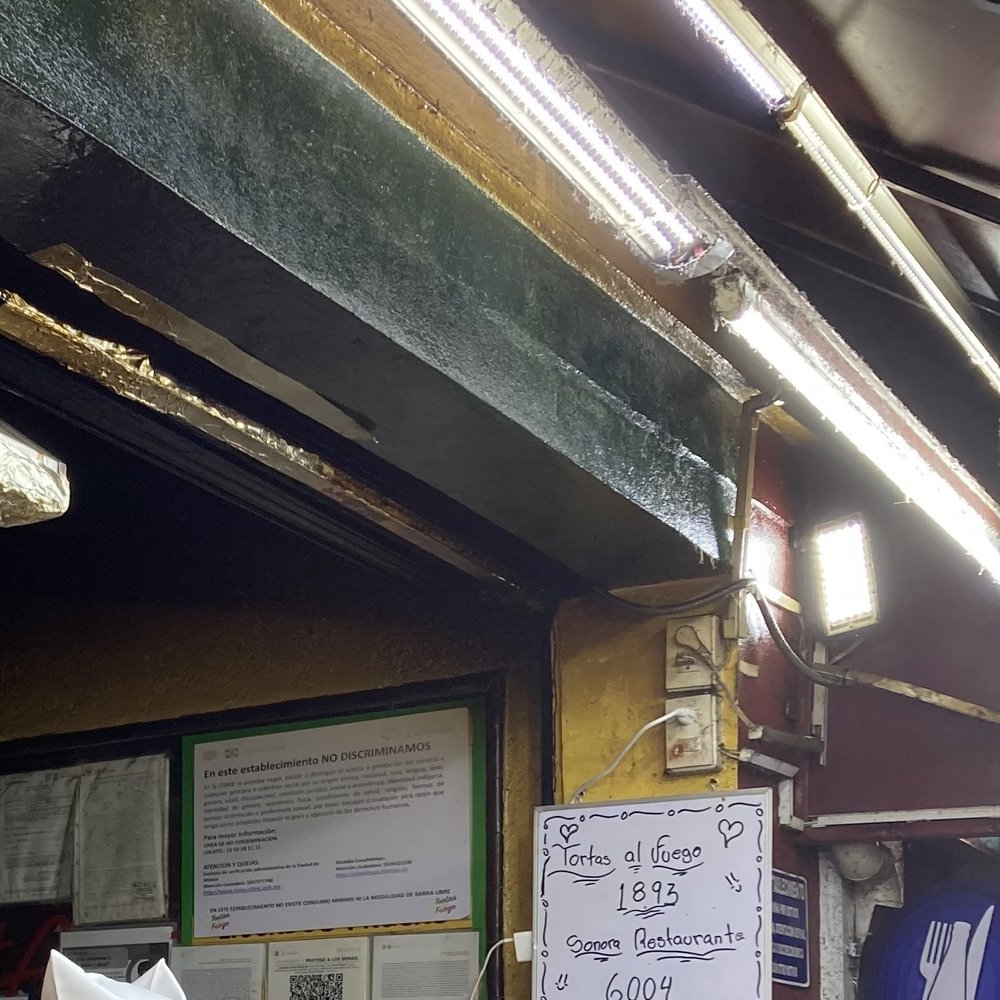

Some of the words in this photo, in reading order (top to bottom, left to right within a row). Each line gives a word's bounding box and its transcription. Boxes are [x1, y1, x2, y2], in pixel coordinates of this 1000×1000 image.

[204, 769, 216, 779] En
[218, 767, 237, 777] este
[240, 757, 318, 774] establecimiento
[321, 753, 337, 763] NO
[341, 741, 431, 761] DISCRIMINAMOS
[552, 843, 612, 867] Tortas
[625, 842, 641, 863] al
[617, 881, 680, 912] 1893
[566, 935, 622, 953] Sonora
